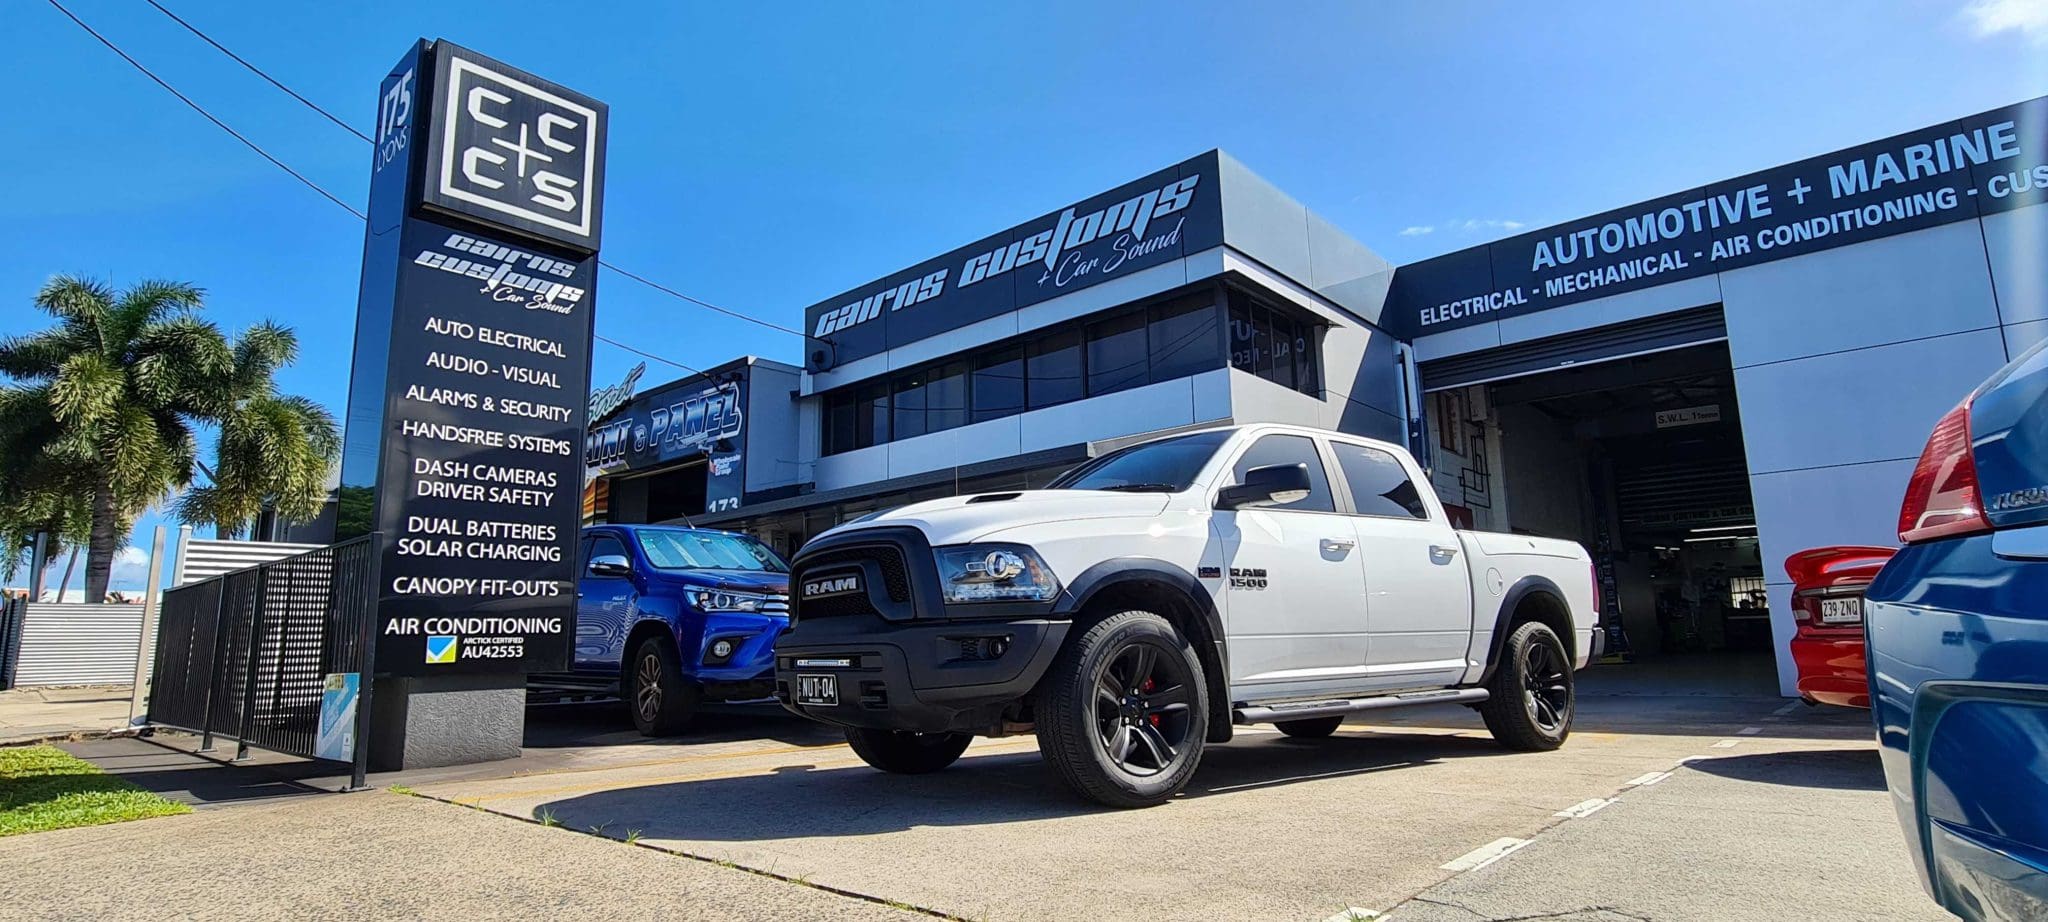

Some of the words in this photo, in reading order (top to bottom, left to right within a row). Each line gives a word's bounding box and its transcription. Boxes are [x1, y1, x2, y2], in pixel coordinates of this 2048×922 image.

[380, 67, 412, 145] 175
[468, 86, 512, 128] C
[537, 112, 578, 153] C
[377, 125, 407, 172] LYONS
[462, 146, 507, 189] C
[531, 170, 577, 212] S
[1532, 184, 1772, 271] AUTOMOTIVE
[1787, 178, 1812, 204] +
[1828, 121, 2021, 199] MARINE
[1055, 251, 1099, 287] Car
[1102, 216, 1186, 273] Sound
[1420, 287, 1528, 326] ELECTRICAL
[1545, 250, 1688, 298] MECHANICAL
[1710, 234, 1751, 262] AIR
[1757, 187, 1958, 250] CONDITIONING
[493, 287, 525, 303] Car
[525, 295, 576, 315] Sound
[424, 317, 474, 340] AUTO
[478, 327, 566, 358] ELECTRICAL
[426, 352, 489, 376] AUDIO
[502, 365, 561, 389] VISUAL
[406, 384, 478, 409] ALARMS
[482, 396, 495, 412] &
[500, 399, 572, 423] SECURITY
[650, 386, 739, 447] PANEL
[402, 420, 504, 448] HANDSFREE
[508, 434, 571, 456] SYSTEMS
[414, 458, 469, 479] DASH
[472, 464, 557, 488] CAMERAS
[417, 480, 485, 502] DRIVER
[488, 487, 554, 507] SAFETY
[408, 516, 462, 536] DUAL
[466, 520, 557, 541] BATTERIES
[397, 538, 463, 558] SOLAR
[466, 542, 561, 562] CHARGING
[393, 577, 477, 595] CANOPY
[480, 579, 559, 597] FIT-OUTS
[805, 577, 857, 595] RAM
[1229, 567, 1267, 577] RAM
[1230, 578, 1268, 588] 1500
[1823, 602, 1838, 617] 239
[1840, 600, 1858, 616] ZNQ
[385, 618, 419, 635] AIR
[423, 617, 561, 635] CONDITIONING
[463, 637, 491, 645] ARCTICK
[492, 637, 524, 645] CERTIFIED
[461, 645, 524, 659] AU42553
